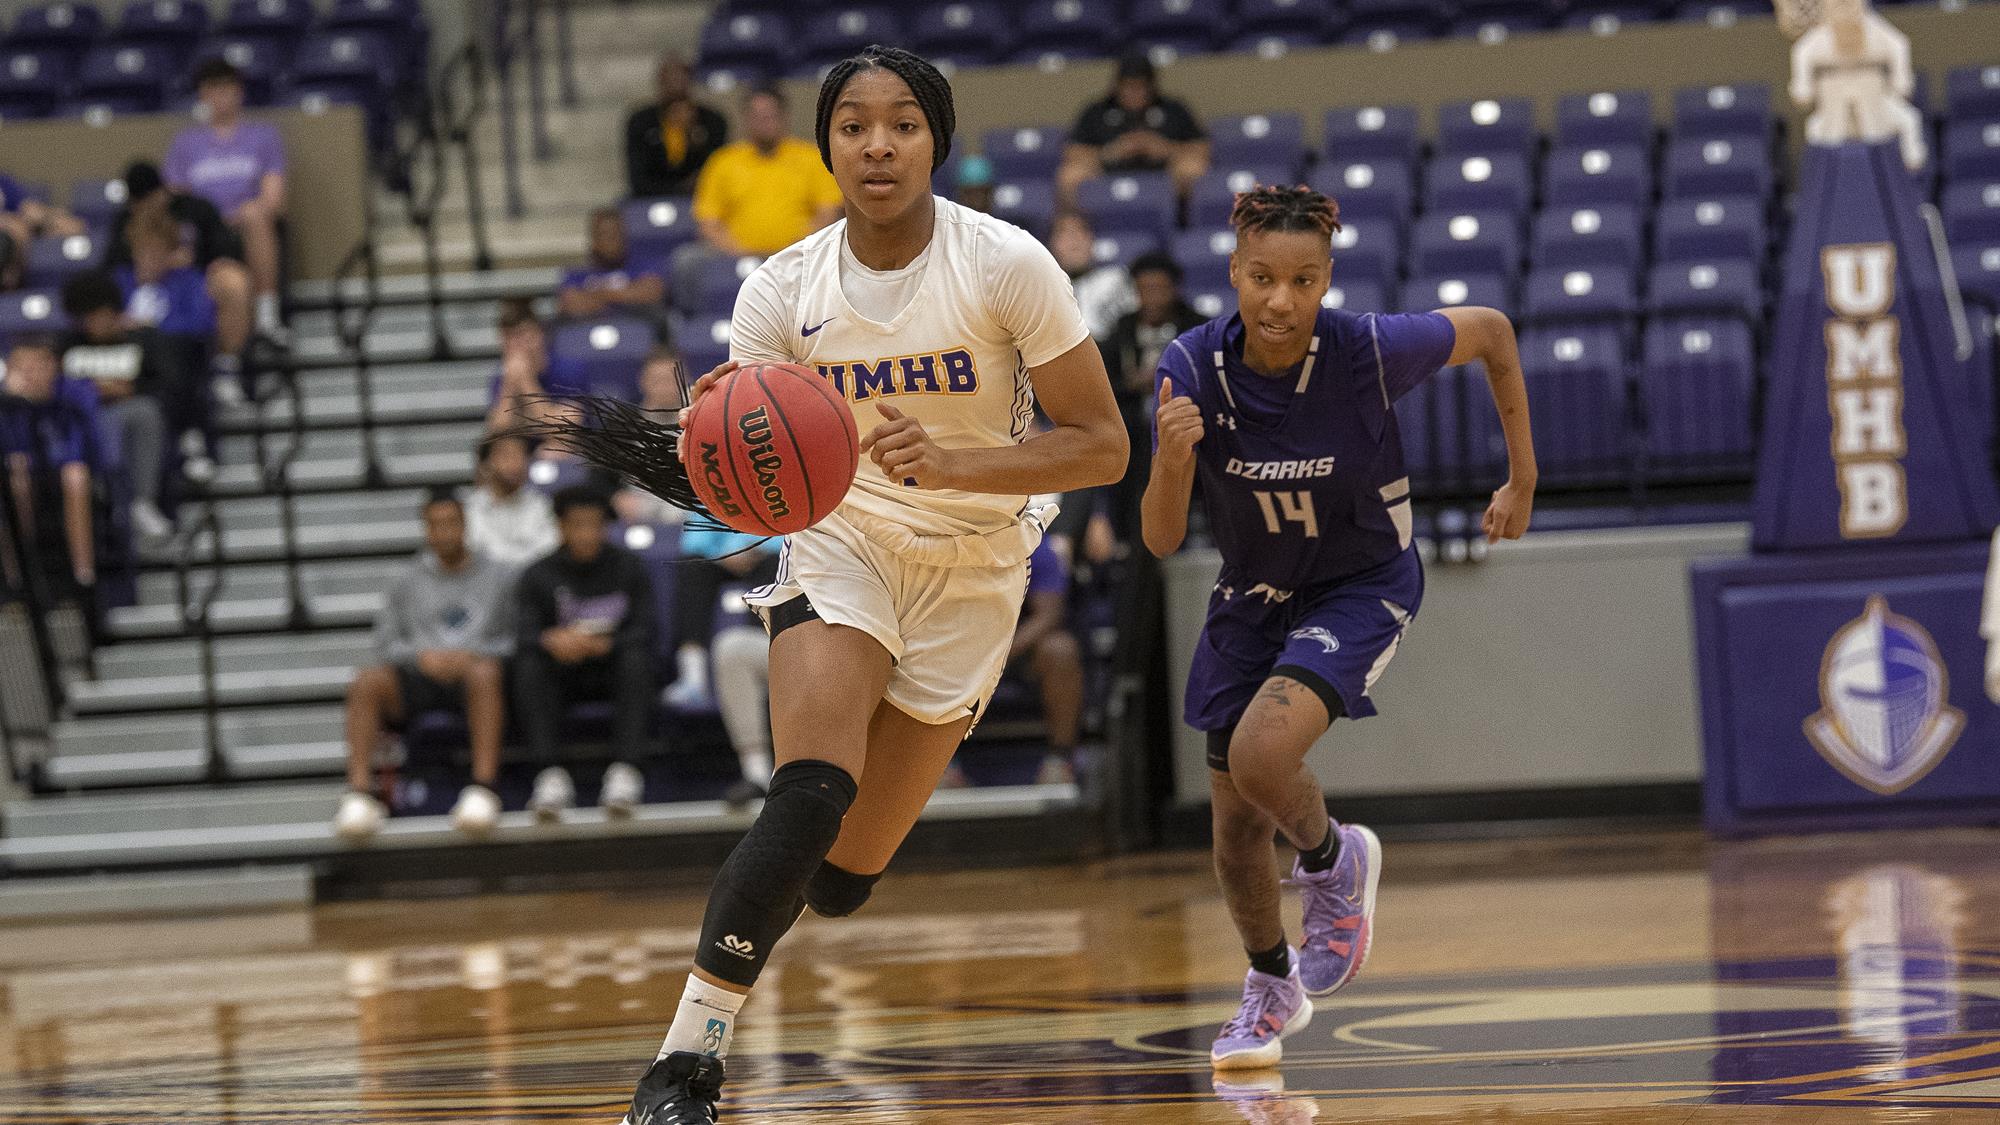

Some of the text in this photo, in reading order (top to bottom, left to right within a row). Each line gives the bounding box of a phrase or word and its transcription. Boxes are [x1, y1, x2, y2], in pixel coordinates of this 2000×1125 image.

[1820, 242, 1908, 539] UMHB
[700, 441, 743, 518] NCAA
[738, 404, 791, 521] Wilson
[1225, 456, 1336, 480] OZARKS
[1253, 490, 1319, 538] 14
